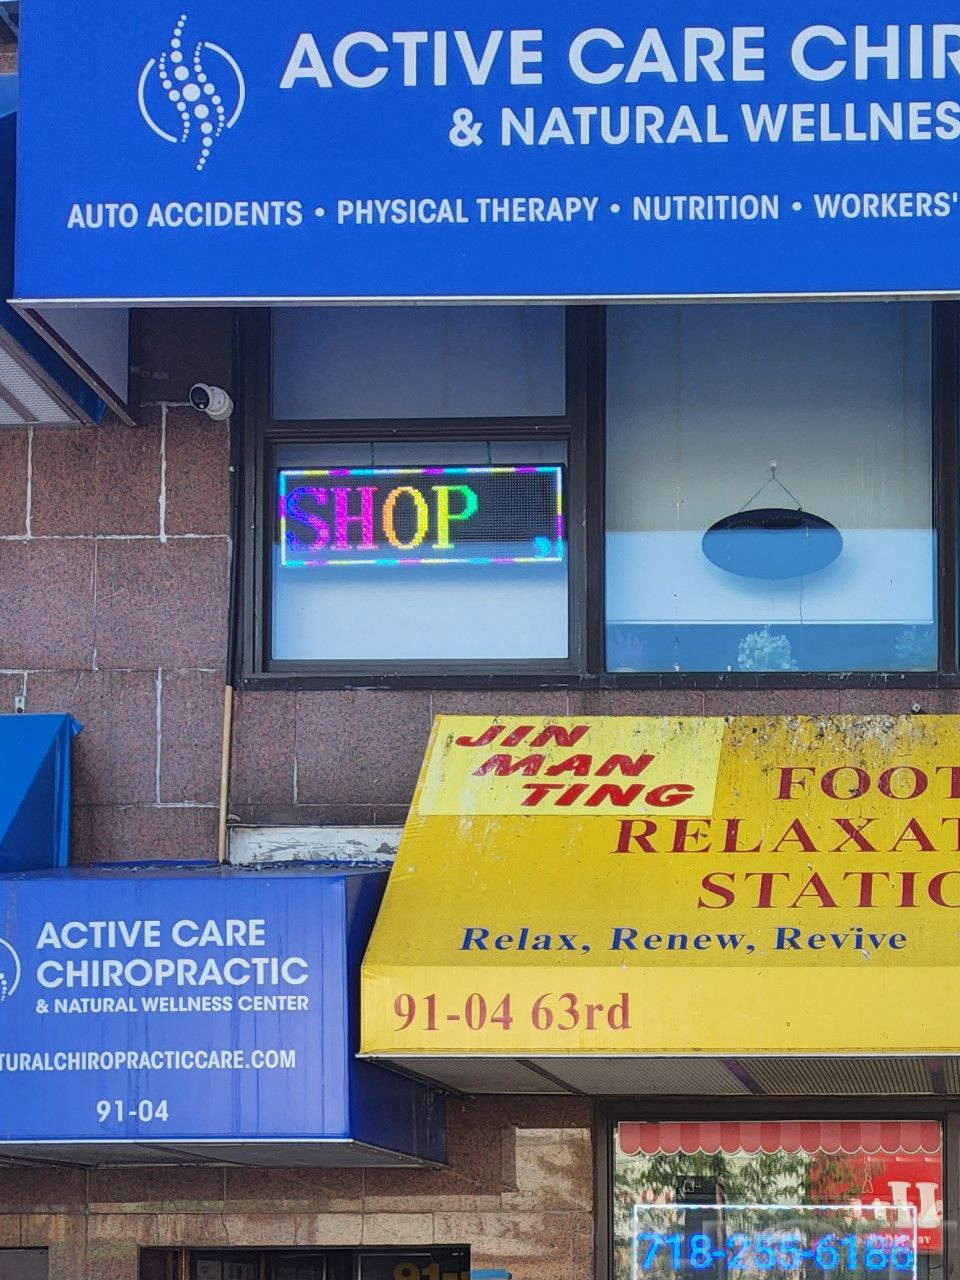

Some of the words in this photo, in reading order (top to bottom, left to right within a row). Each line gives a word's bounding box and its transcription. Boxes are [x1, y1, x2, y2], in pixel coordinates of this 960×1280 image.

[279, 29, 543, 89] ACTIVE
[554, 26, 765, 85] CARE
[449, 107, 483, 148] &
[501, 103, 728, 146] NATURAL
[67, 203, 138, 229] AUTO
[147, 200, 303, 228] ACCIDENTS
[337, 198, 469, 225] PHYSICAL
[476, 197, 598, 223] THERAPY
[632, 195, 779, 221] NUTRITION
[814, 191, 958, 219] WORKERS'
[284, 485, 478, 553] SHOP
[455, 725, 590, 747] JIN
[472, 754, 656, 777] MAN
[521, 783, 695, 808] TING
[36, 920, 161, 949] ACTIVE
[172, 919, 265, 946] CARE
[458, 927, 591, 955] Relax,
[608, 926, 755, 955] Renew,
[774, 926, 908, 951] Revive
[36, 957, 309, 988] CHIROPRACTIC
[36, 999, 48, 1014] &
[54, 998, 137, 1013] NATURAL
[142, 997, 232, 1012] WELLNESS
[238, 995, 309, 1011] CENTER
[394, 992, 513, 1032] 91-04
[531, 992, 632, 1031] 63rd
[96, 1100, 169, 1122] 91-04
[637, 1232, 914, 1272] 718-255-6186
